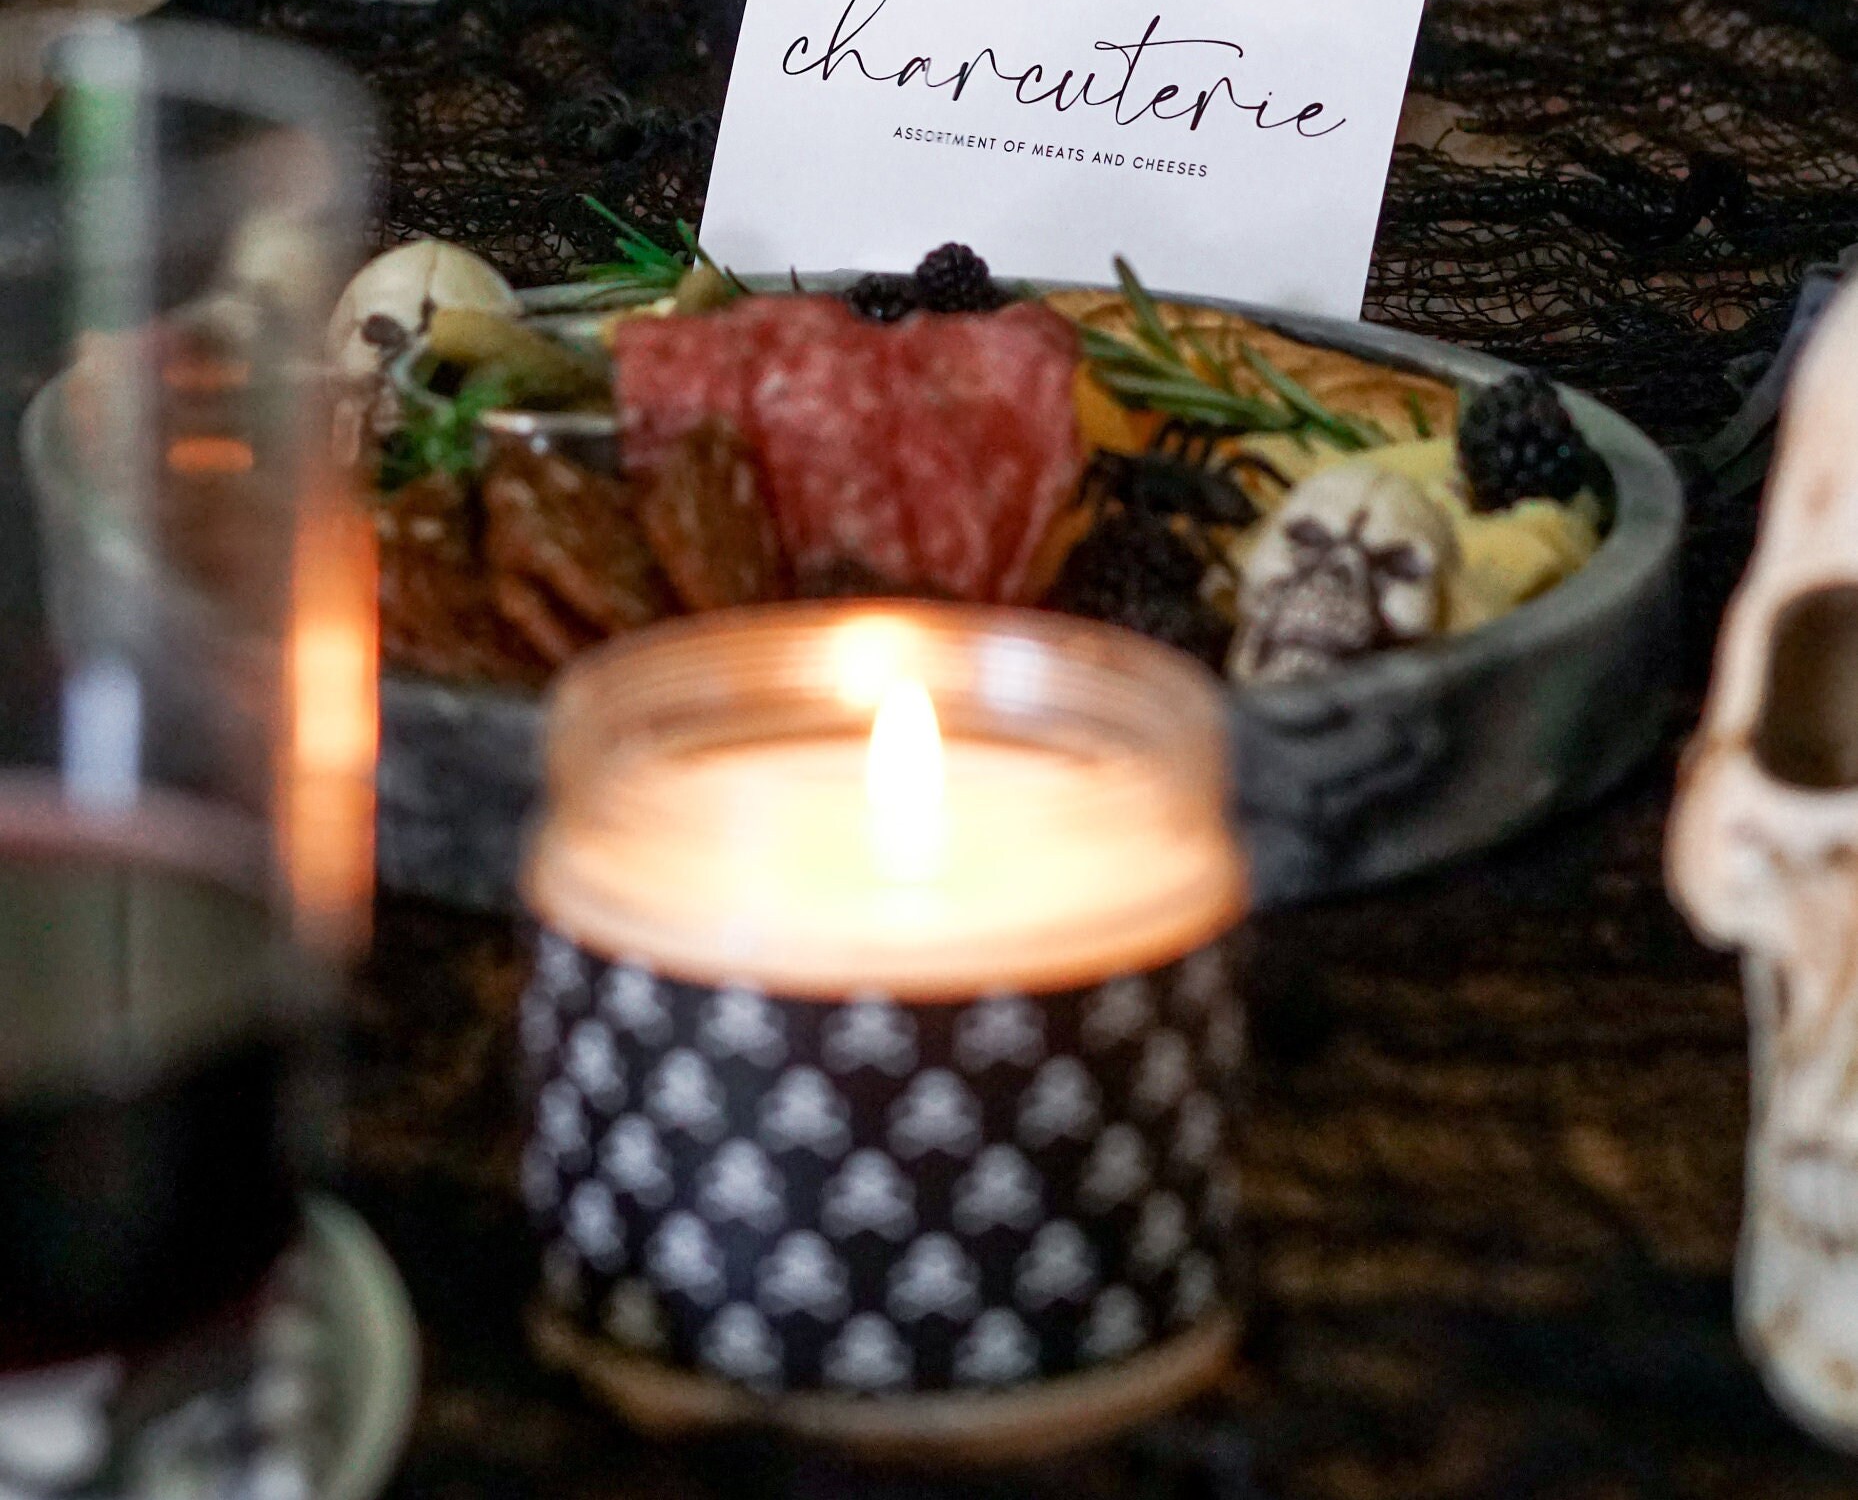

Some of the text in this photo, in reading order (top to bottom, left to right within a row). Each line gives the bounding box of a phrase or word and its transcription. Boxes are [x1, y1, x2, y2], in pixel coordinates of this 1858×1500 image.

[892, 126, 1208, 178] ASSORTMENT OF MEATS AND CHEESES
